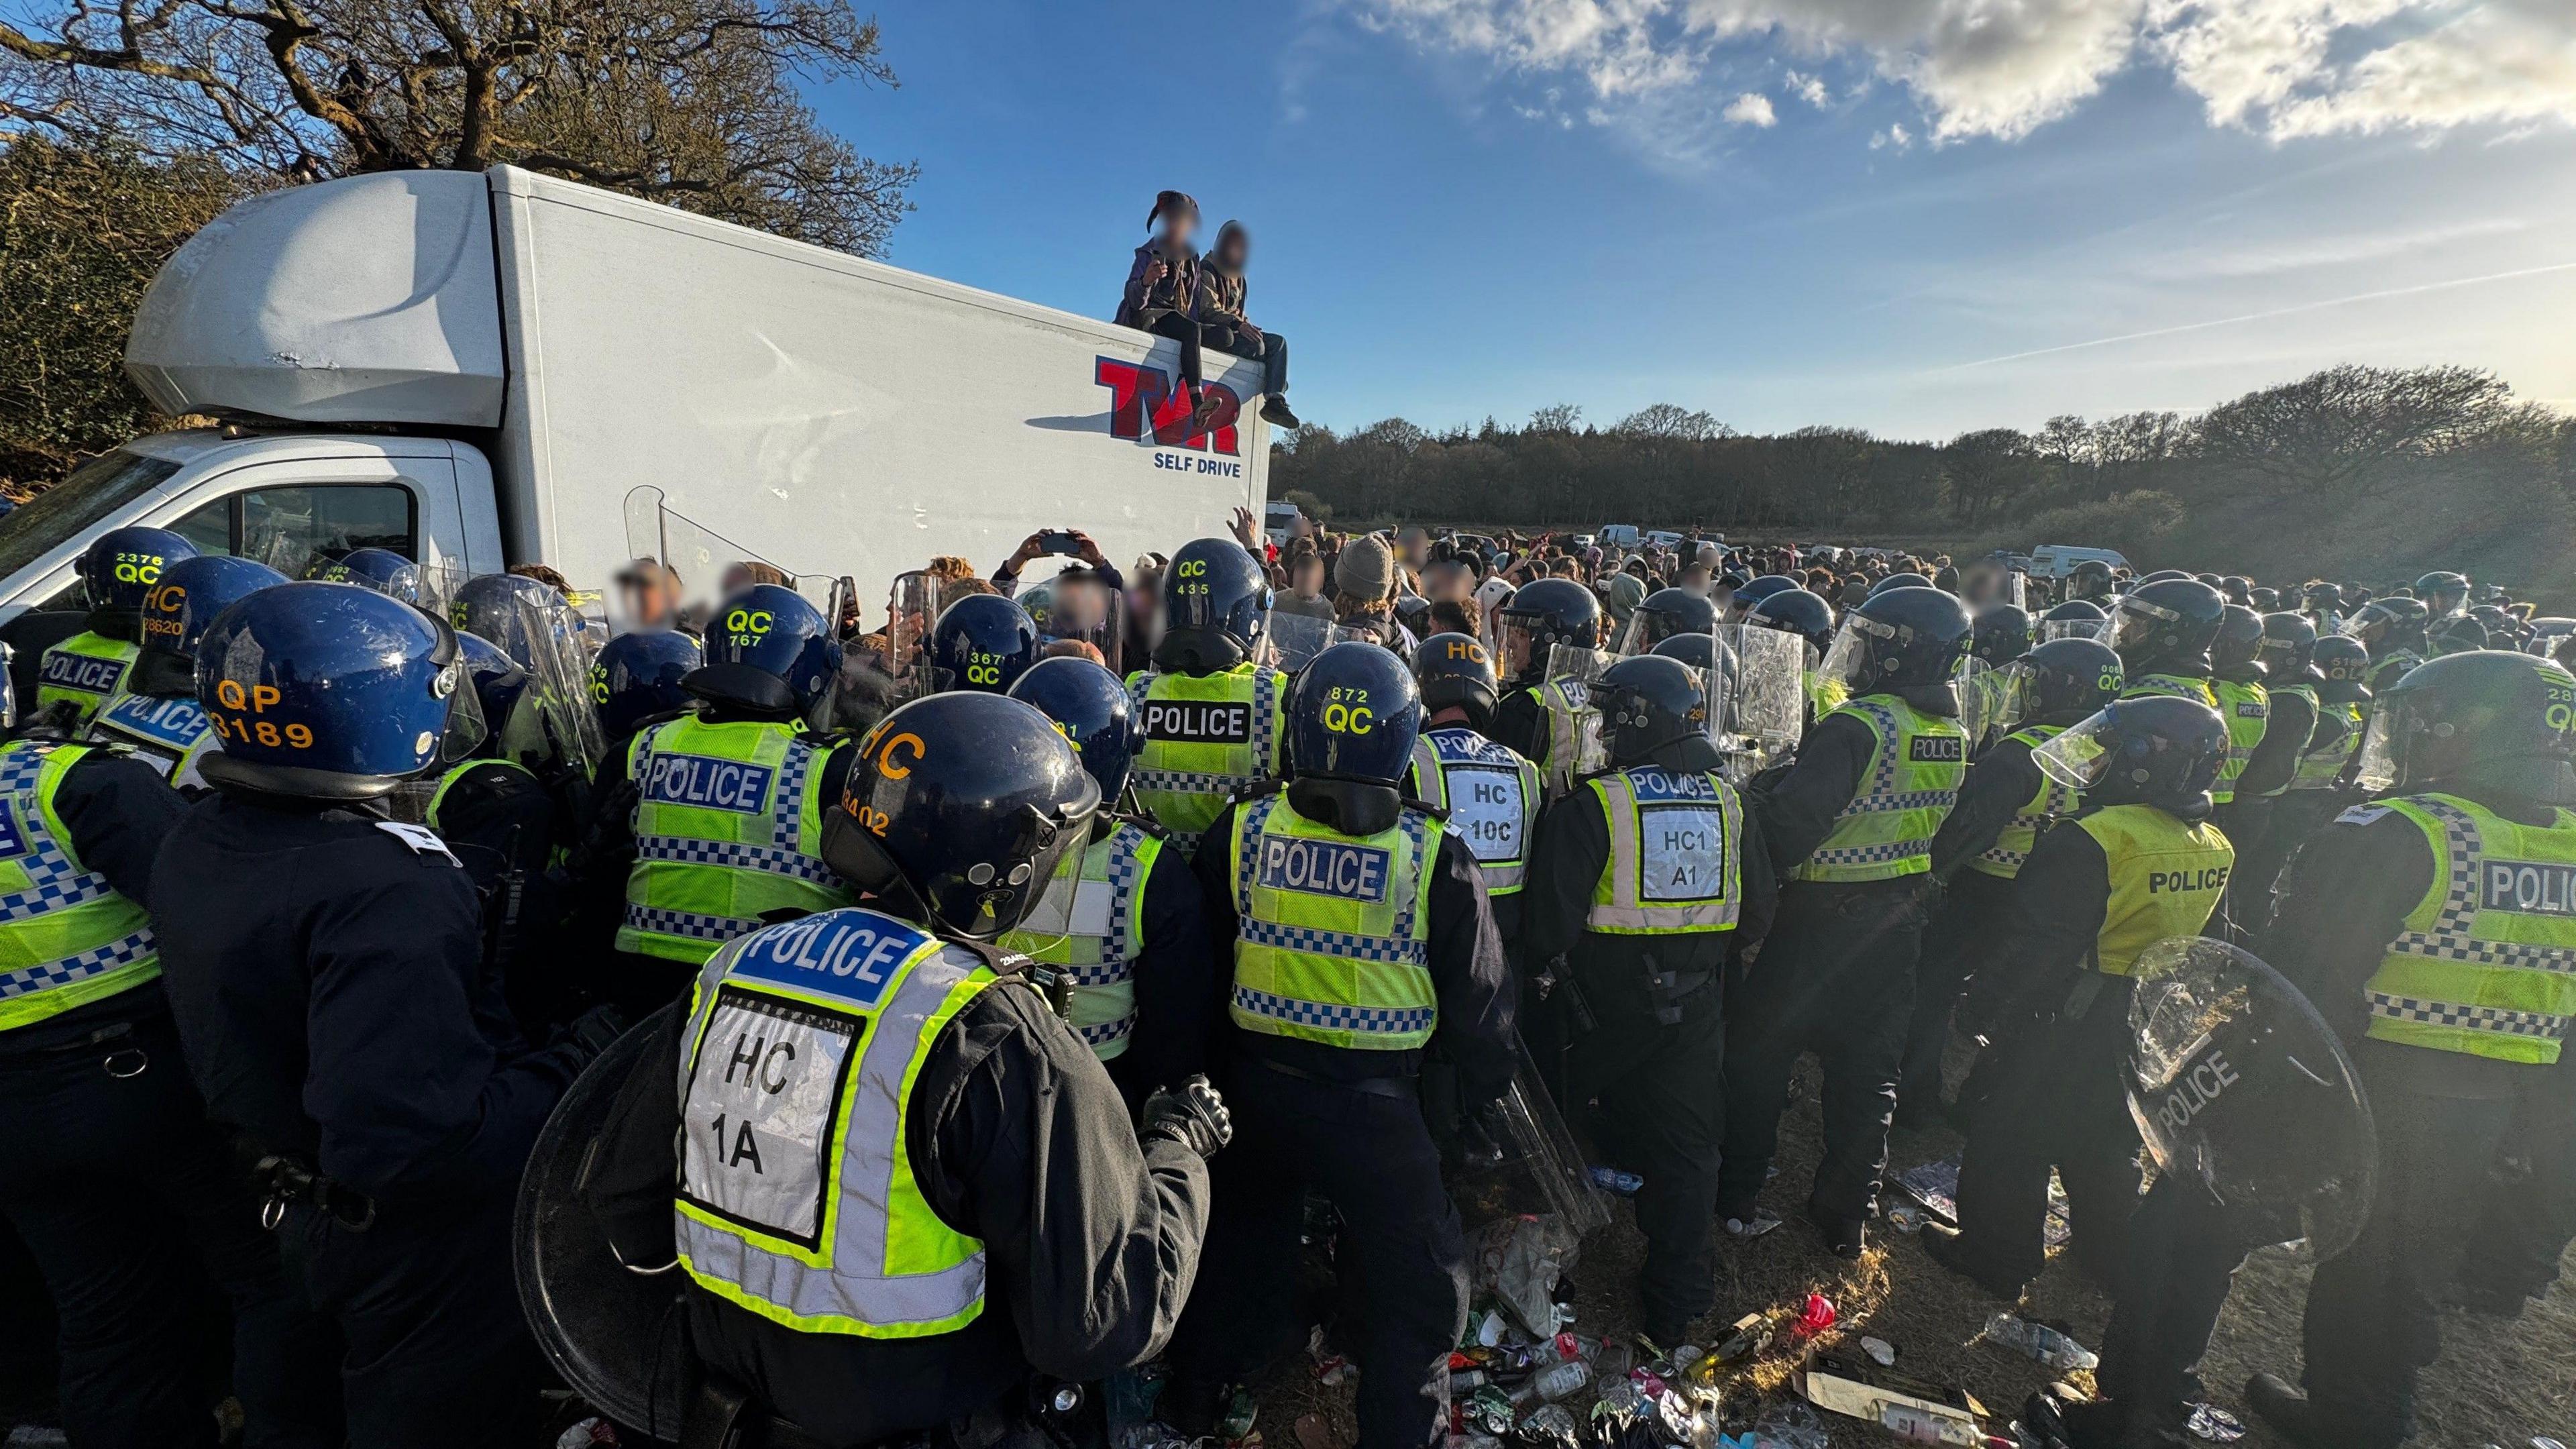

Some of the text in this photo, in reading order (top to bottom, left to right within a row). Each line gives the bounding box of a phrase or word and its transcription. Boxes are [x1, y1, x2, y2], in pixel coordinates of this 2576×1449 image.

[1155, 453, 1241, 478] SELF DRIVE
[116, 553, 164, 566] 2376
[1179, 560, 1205, 577] QC
[115, 564, 161, 584] QC
[1177, 584, 1208, 595] 435
[727, 610, 771, 633] QC
[730, 635, 761, 647] 767
[971, 652, 1002, 665] 367
[40, 653, 119, 689] POLICE
[968, 665, 1000, 684] QC
[2098, 674, 2123, 692] QC
[218, 680, 280, 713] QP
[1331, 687, 1368, 703] 872
[211, 712, 313, 749] 3189
[1147, 706, 1244, 736] POLICE
[1325, 703, 1373, 735] QC
[1913, 739, 1960, 758] POLICE
[648, 758, 762, 808] POLICE
[1474, 783, 1507, 804] HC
[1628, 772, 1715, 799] POLICE
[1470, 819, 1511, 841] 10C
[1664, 830, 1705, 851] HC1
[1266, 841, 1380, 896] POLICE
[1671, 865, 1697, 885] A1
[2149, 867, 2229, 894] POLICE
[2491, 865, 2576, 912] POLI
[748, 923, 908, 984] POLICE
[725, 1033, 796, 1095] HC
[2157, 1050, 2240, 1138] POLICE
[711, 1113, 763, 1175] 1A
